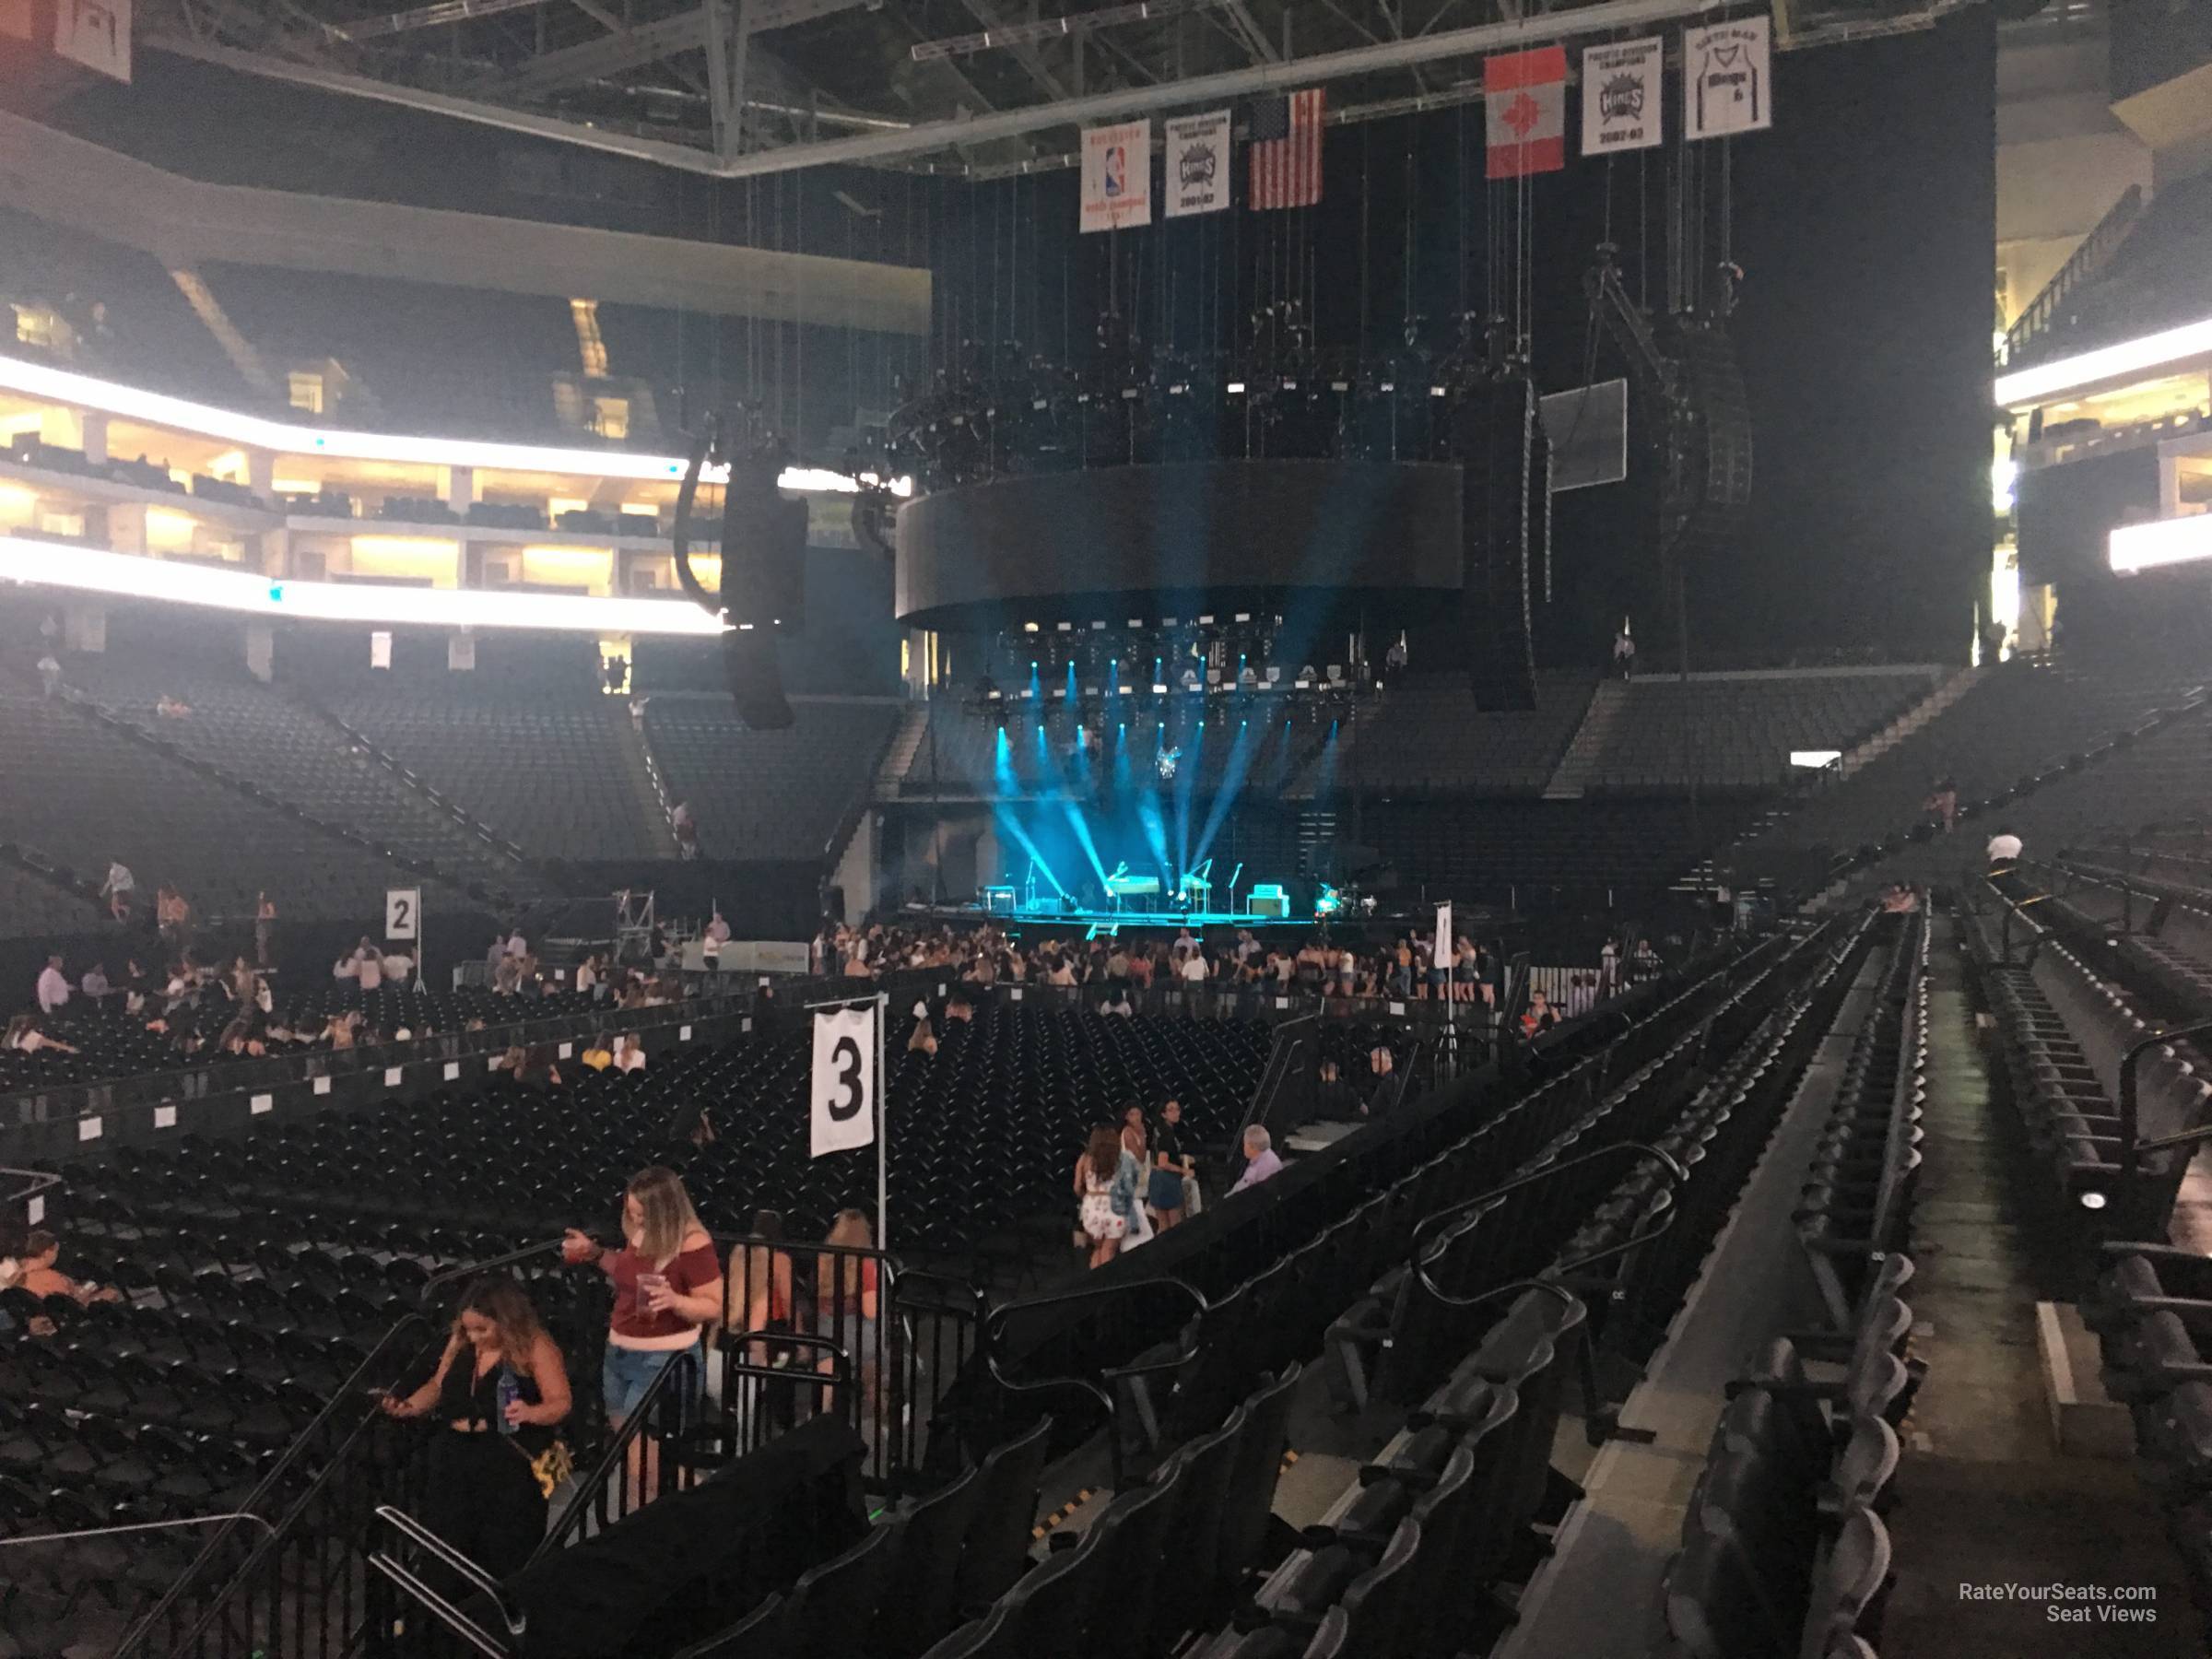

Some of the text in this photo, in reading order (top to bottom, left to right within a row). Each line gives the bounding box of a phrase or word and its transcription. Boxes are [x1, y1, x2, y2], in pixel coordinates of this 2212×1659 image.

[1731, 29, 1758, 41] MAN
[1622, 43, 1657, 57] DIVISION
[1599, 55, 1646, 70] CHAMPIONS
[1602, 88, 1642, 112] KINGS
[1734, 88, 1744, 102] 6
[1182, 157, 1214, 179] KINGS
[393, 899, 409, 930] 2
[828, 1035, 864, 1123] 3
